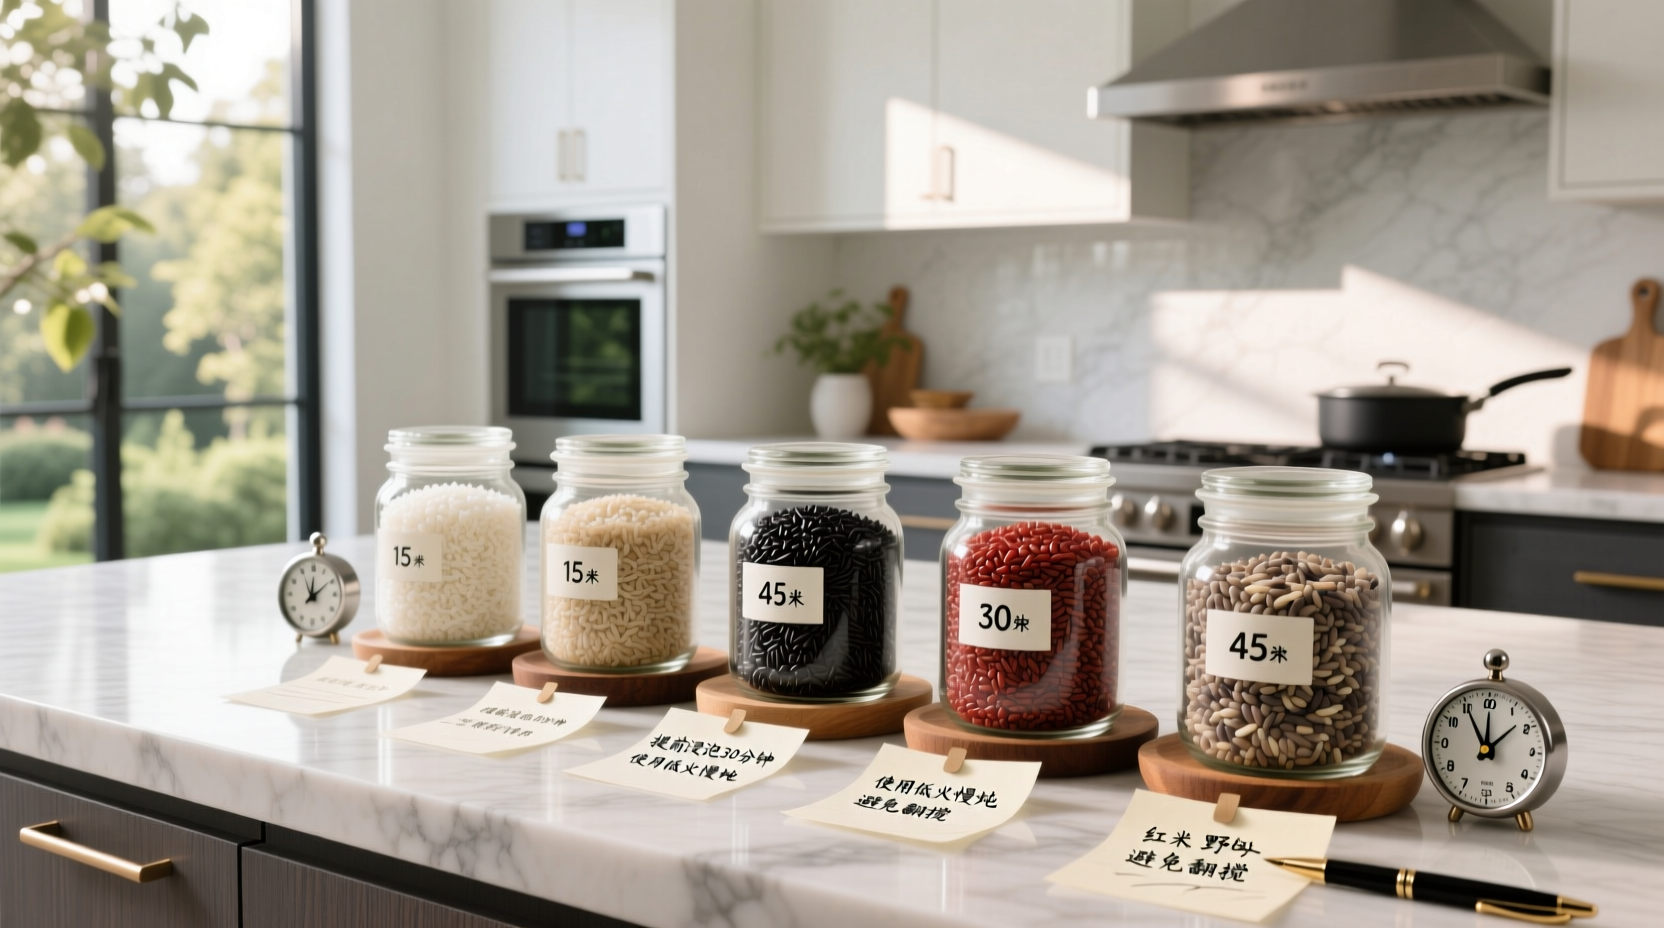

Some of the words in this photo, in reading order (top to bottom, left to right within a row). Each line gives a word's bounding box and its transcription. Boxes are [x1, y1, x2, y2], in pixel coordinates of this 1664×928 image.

[393, 545, 425, 569] 15米
[563, 560, 599, 585] 15米
[758, 581, 805, 608] 45米
[1229, 631, 1288, 664] 45米
[875, 775, 998, 809] 使用低火慢炖
[1142, 826, 1192, 849] 红米
